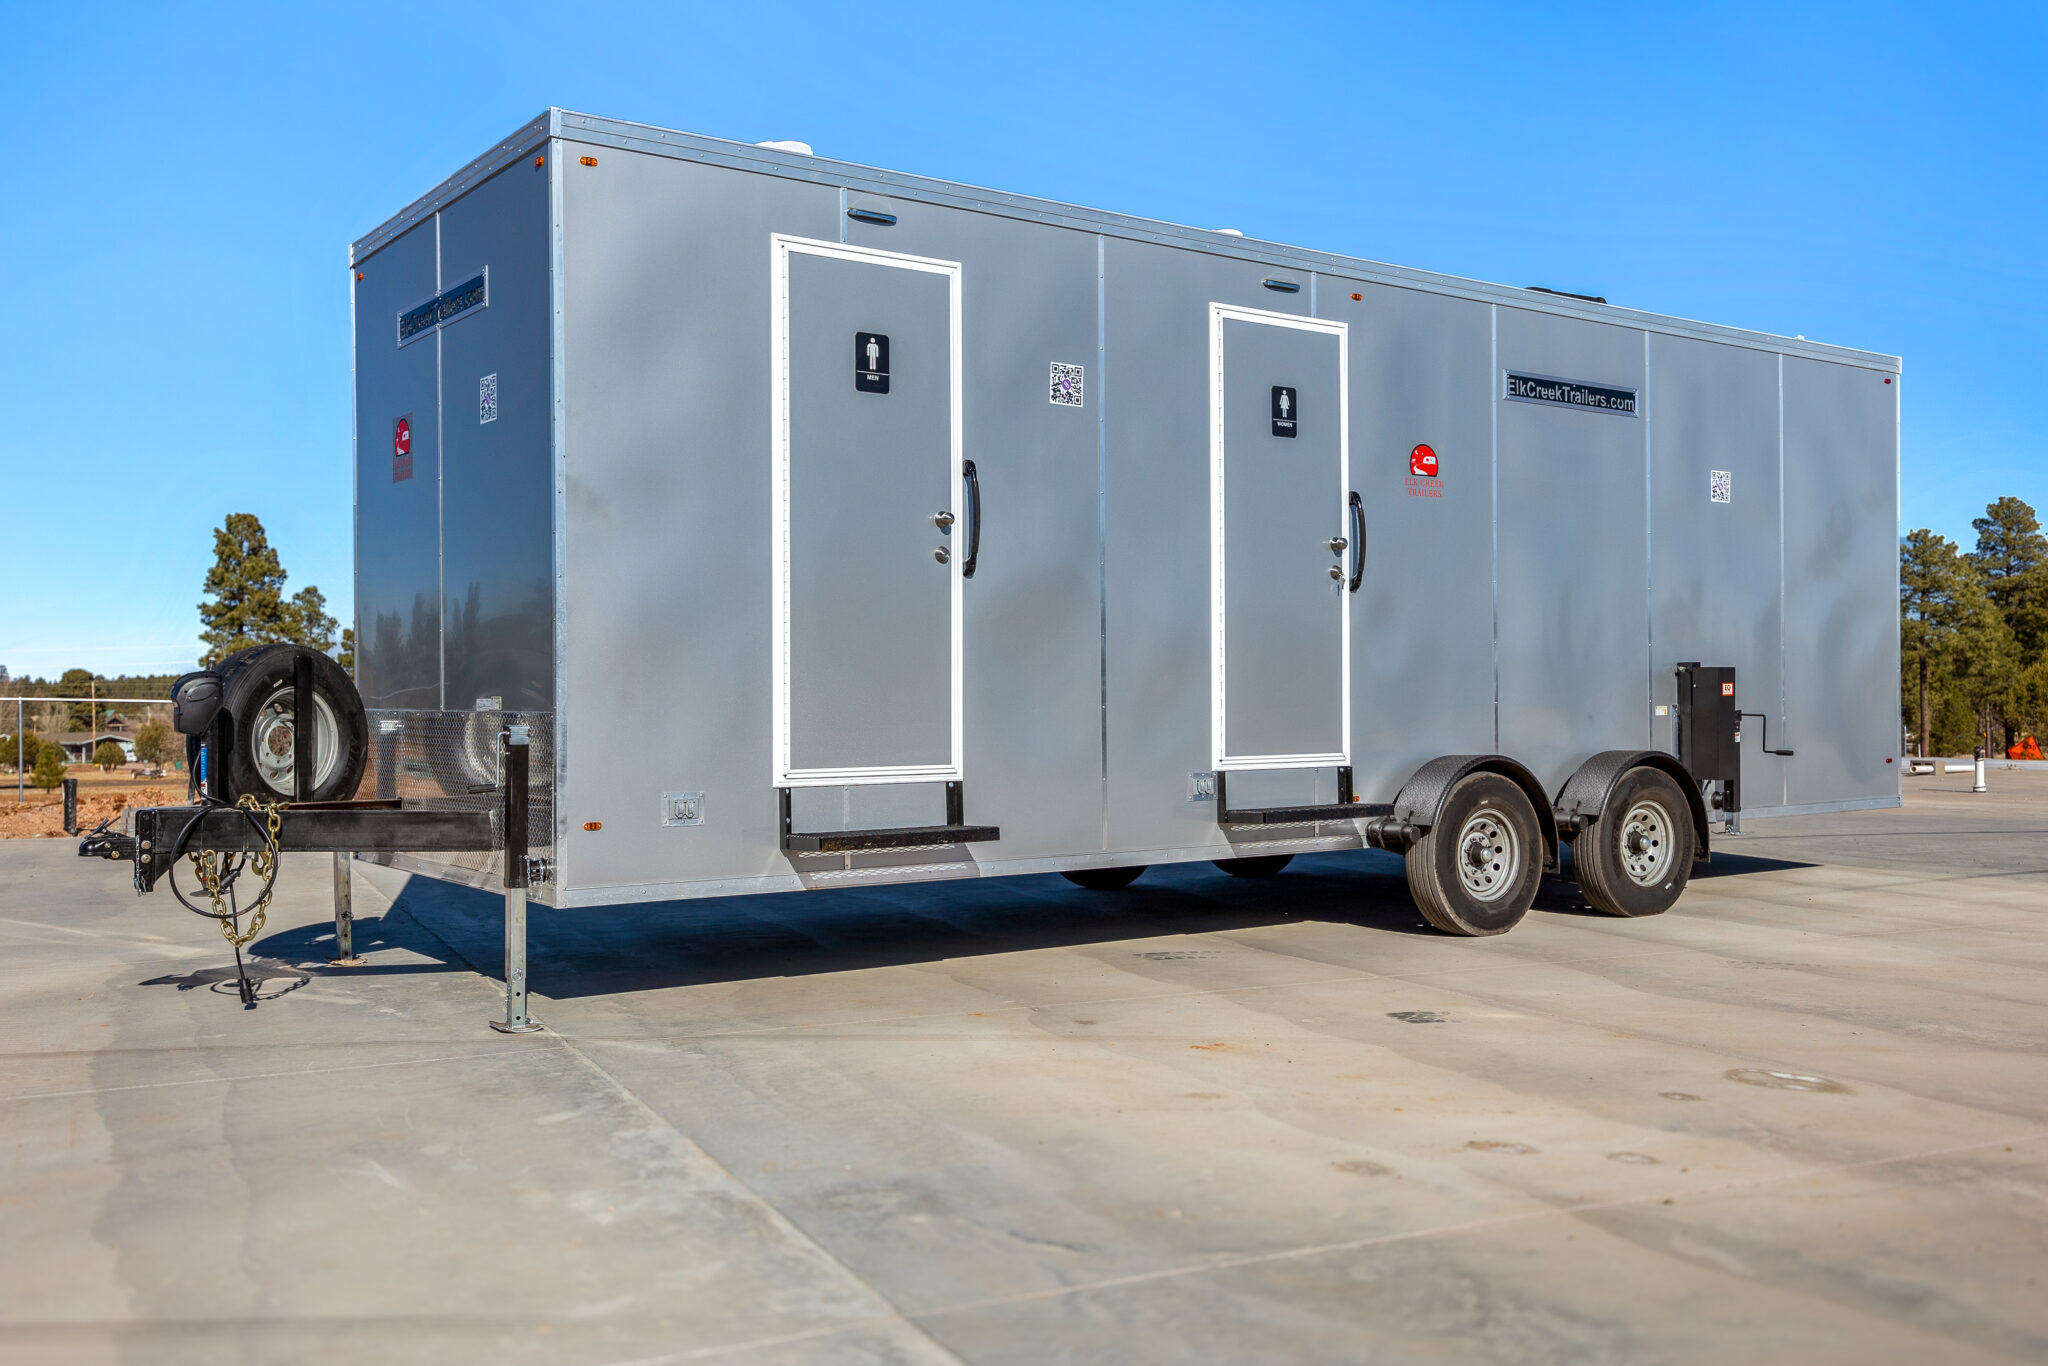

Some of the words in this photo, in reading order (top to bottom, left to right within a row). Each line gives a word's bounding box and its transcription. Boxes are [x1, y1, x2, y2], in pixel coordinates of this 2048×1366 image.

[1507, 378, 1635, 411] ElkCreekTrailers.com
[1404, 477, 1418, 486] ELK
[1419, 478, 1444, 488] CREEK
[1408, 488, 1442, 498] TRAILERS
